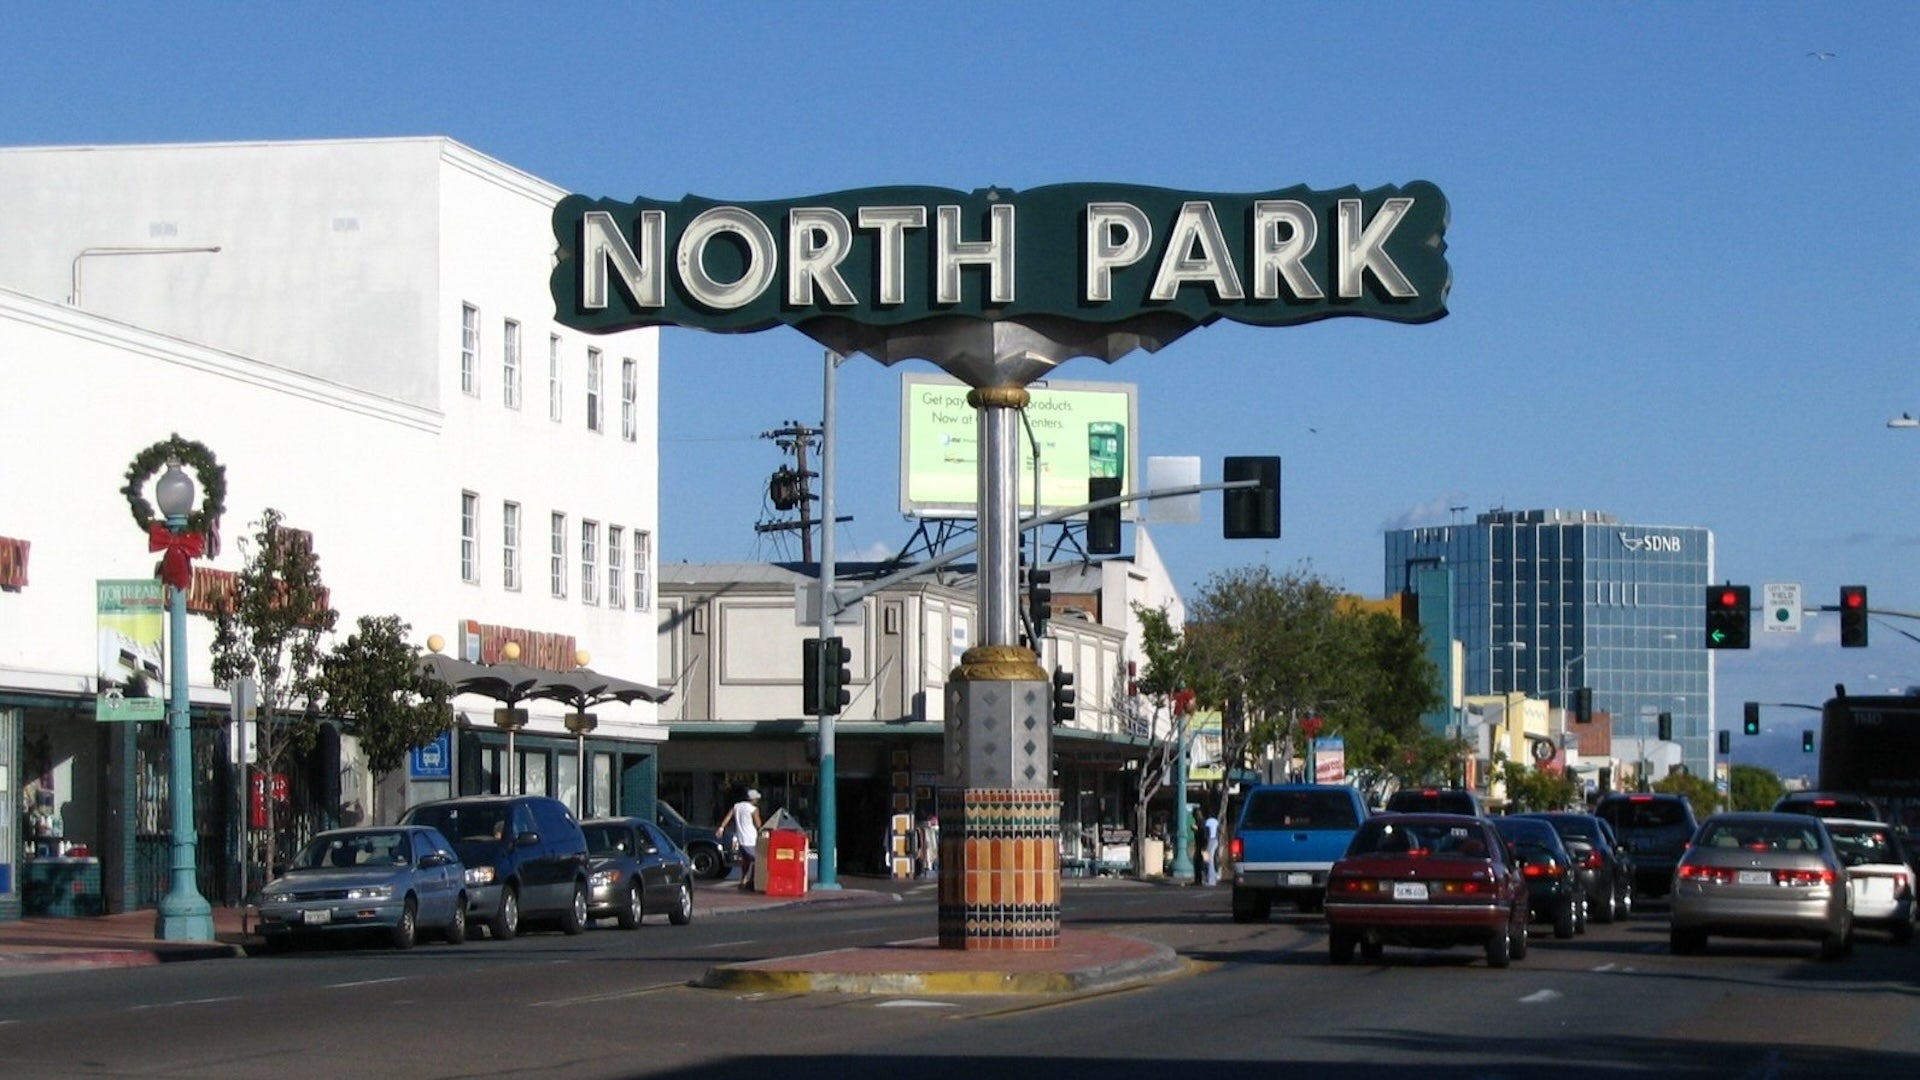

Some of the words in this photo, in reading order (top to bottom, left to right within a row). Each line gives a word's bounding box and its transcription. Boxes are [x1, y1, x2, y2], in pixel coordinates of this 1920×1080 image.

[581, 203, 1016, 309] NORTH
[1085, 197, 1420, 303] PARK
[922, 392, 942, 406] Get
[1027, 397, 1073, 414] products.
[932, 412, 958, 424] Now
[962, 414, 972, 425] at
[1644, 535, 1681, 552] SDNB
